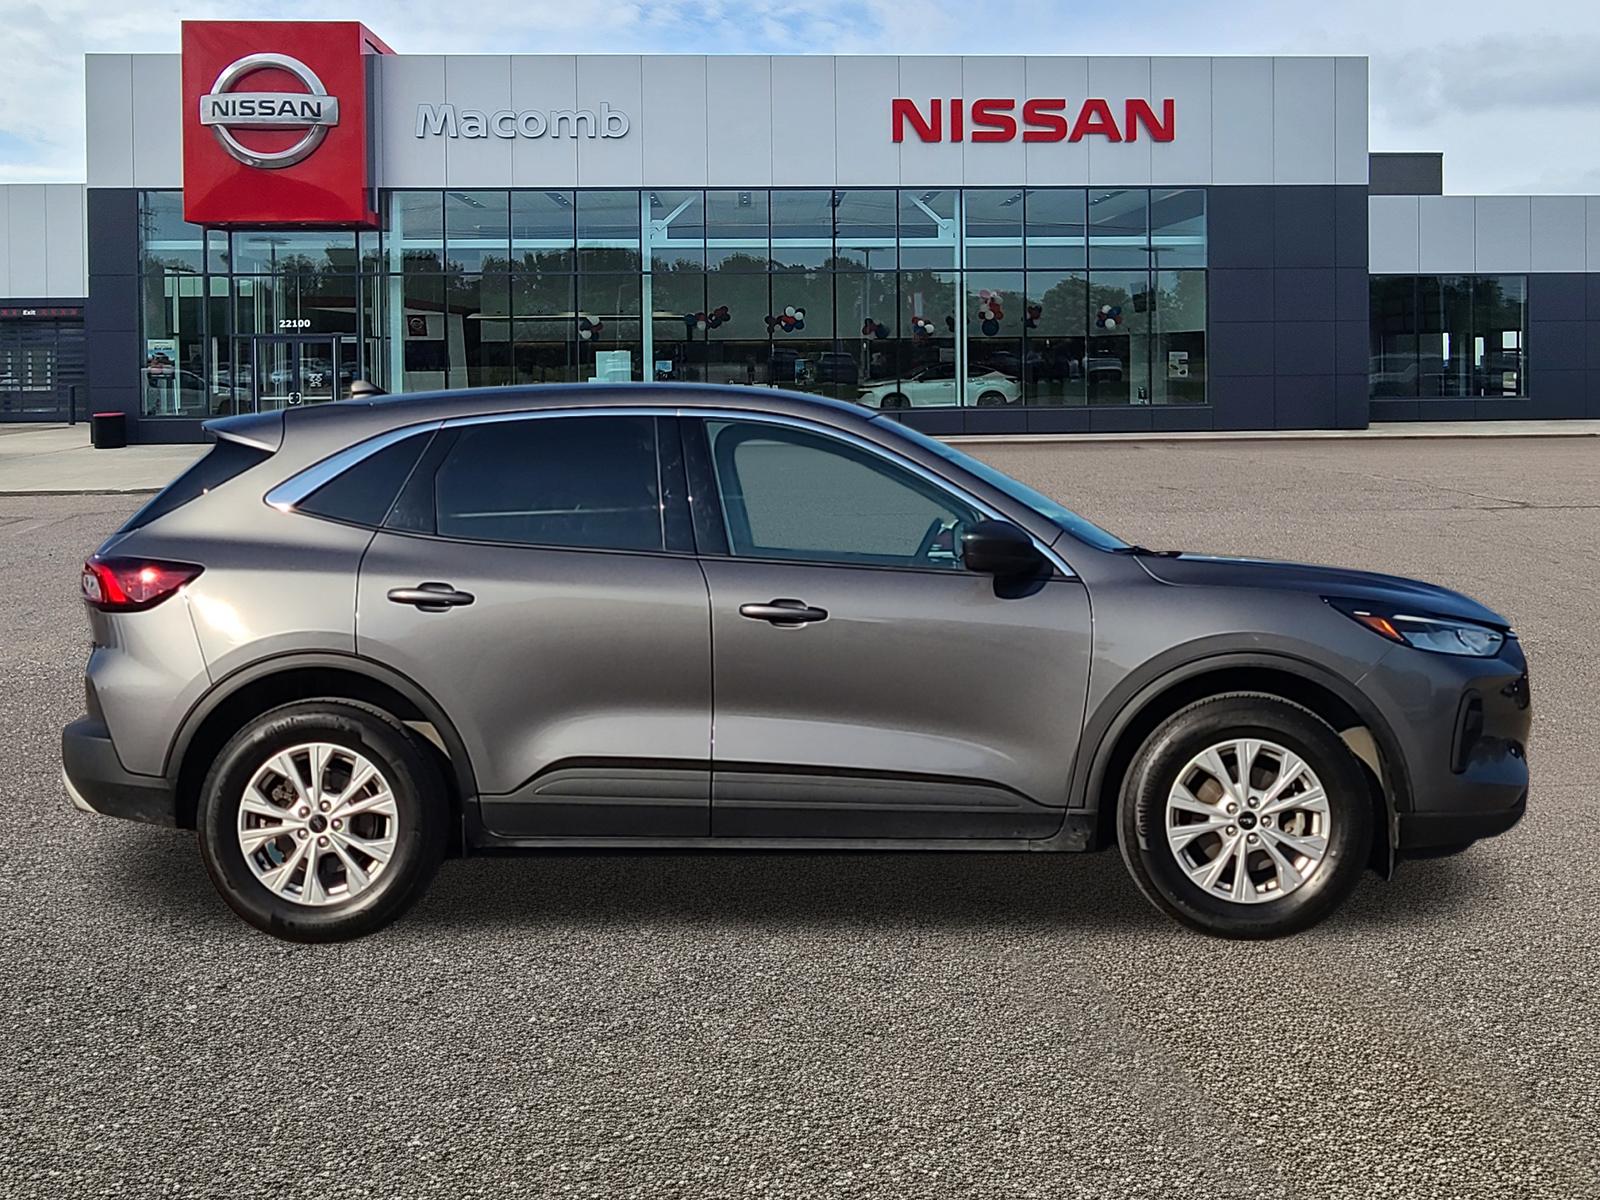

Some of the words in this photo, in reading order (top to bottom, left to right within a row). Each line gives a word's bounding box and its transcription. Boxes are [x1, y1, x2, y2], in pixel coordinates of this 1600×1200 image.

[211, 100, 321, 118] NISSAN
[415, 101, 630, 139] Macomb
[892, 98, 1175, 143] NISSAN
[279, 319, 311, 328] 22100
